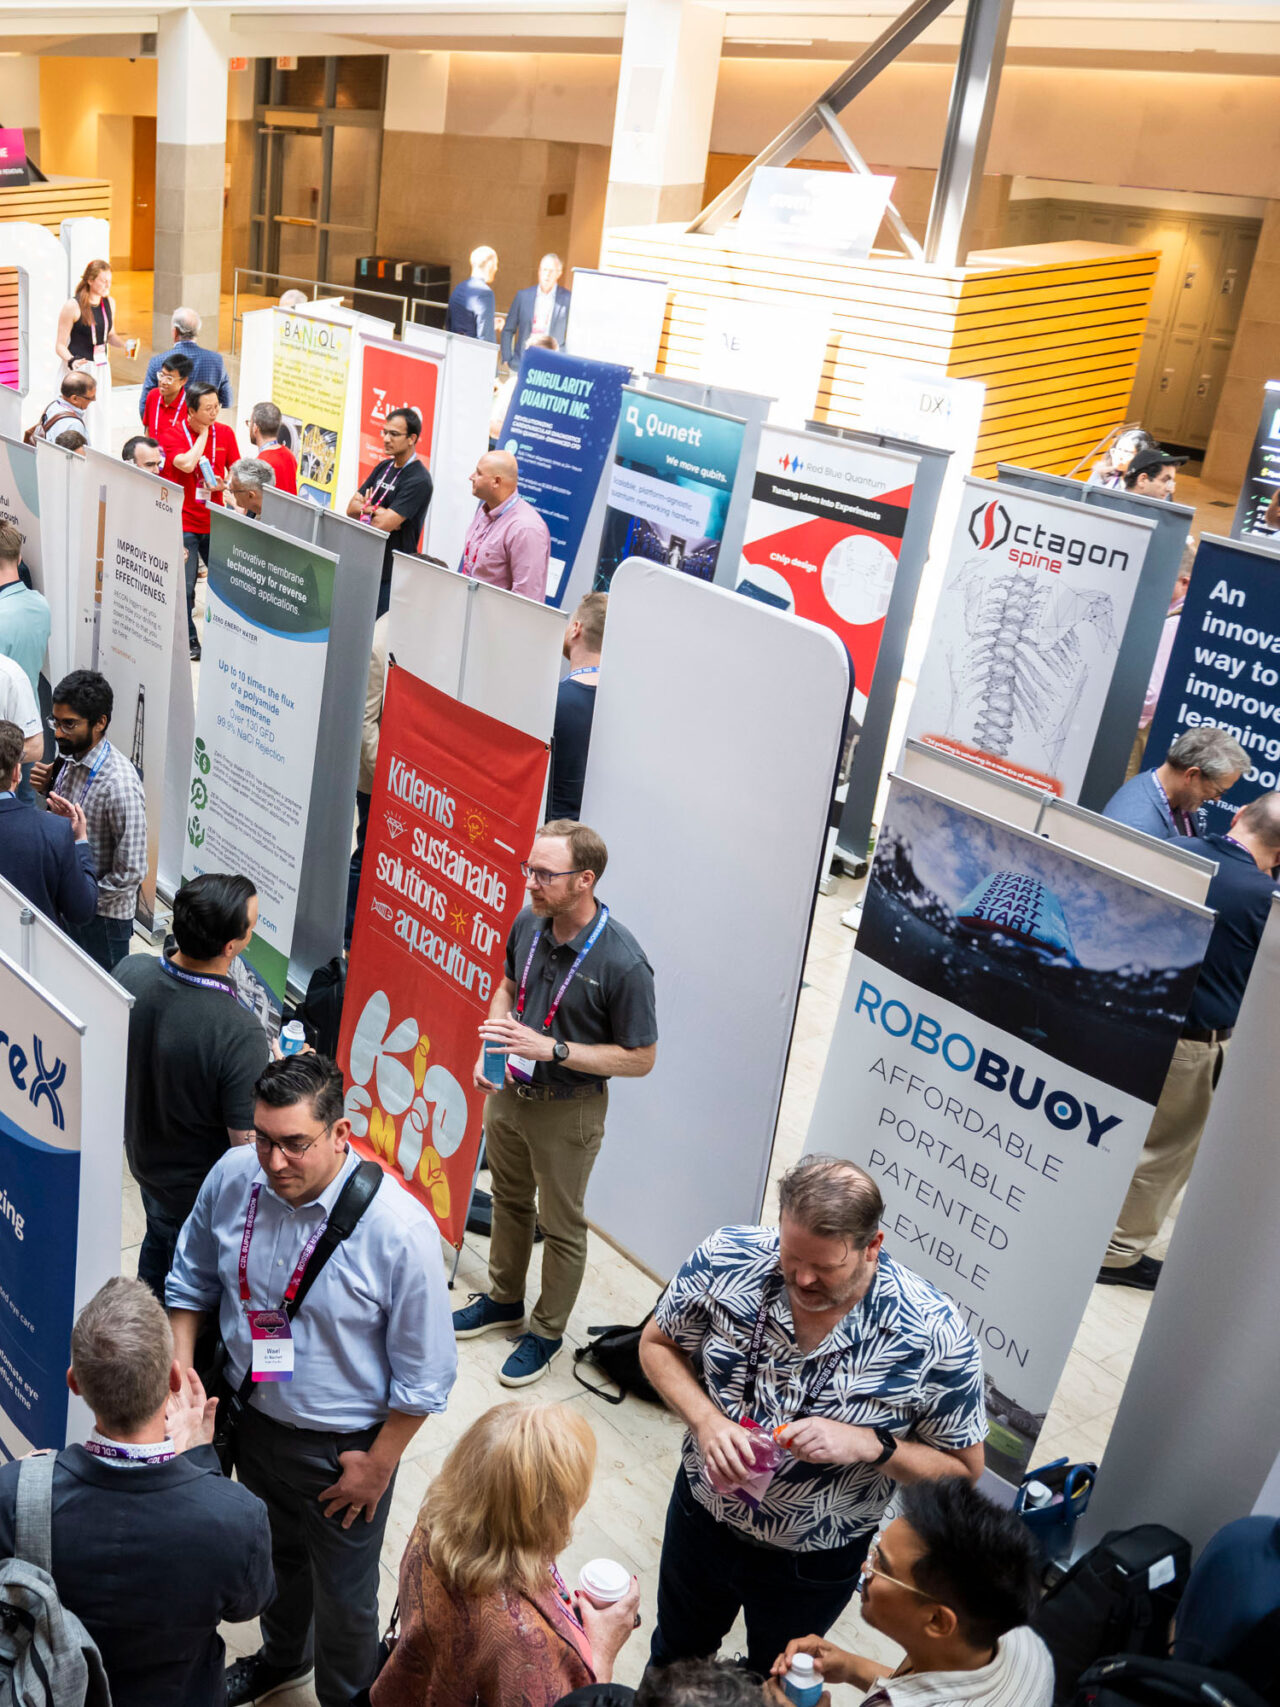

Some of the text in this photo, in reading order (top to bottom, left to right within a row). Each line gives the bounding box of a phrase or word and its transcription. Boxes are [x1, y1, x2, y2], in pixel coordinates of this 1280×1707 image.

[526, 368, 594, 398] SINGULARITY
[520, 389, 590, 420] QUANTUM INC.
[645, 415, 703, 447] Qunett
[666, 454, 727, 483] We move qubits.
[806, 462, 887, 490] Red Blue Quantum
[155, 500, 174, 514] RECON
[771, 485, 881, 521] Turning Experiments
[116, 538, 169, 574] IMPROVE YOUR
[116, 554, 164, 588] OPERATIONAL
[232, 544, 305, 586] Innovative membrane
[769, 552, 818, 573] Chip design
[1007, 548, 1062, 575] spine
[114, 569, 168, 606] EFFECTIVENESS.
[227, 557, 308, 603] technology for reverse
[230, 575, 301, 616] osmosis applications.
[1208, 579, 1247, 608] An
[212, 613, 258, 643] ZERO ENERGY WATER
[218, 658, 295, 710] Up to 10 times the flux
[1194, 646, 1279, 687] way to
[230, 680, 281, 717] of polyamide
[234, 698, 272, 726] membrane
[217, 714, 286, 765] 99.9% NaCl Rejection
[229, 707, 276, 743] Over 130 GFD
[387, 756, 457, 829] Kidemis
[411, 827, 507, 914] sustainable
[994, 873, 1045, 891] START
[375, 851, 501, 957] solutions for
[984, 887, 1044, 909] START
[990, 880, 1045, 899] START
[972, 905, 1041, 937] START
[978, 896, 1043, 920] START
[394, 907, 492, 1002] aquaculture
[854, 979, 1124, 1148] ROBOBUOY
[868, 1057, 1064, 1182] AFFORDABLE
[878, 1107, 1026, 1213] PORTABLE
[868, 1148, 1009, 1250] PATENTED
[239, 1197, 257, 1269] SESSION SUPER CDL
[297, 1222, 328, 1272] SUPER SESSION
[877, 1203, 991, 1291] LEXIBLE
[9, 1301, 20, 1318] eye
[19, 1314, 35, 1334] care
[749, 1323, 764, 1365] CDL SUPER
[14, 1385, 32, 1411] time
[23, 1381, 39, 1401] eye
[809, 1368, 832, 1399] SESSION
[101, 1446, 117, 1457] CDL
